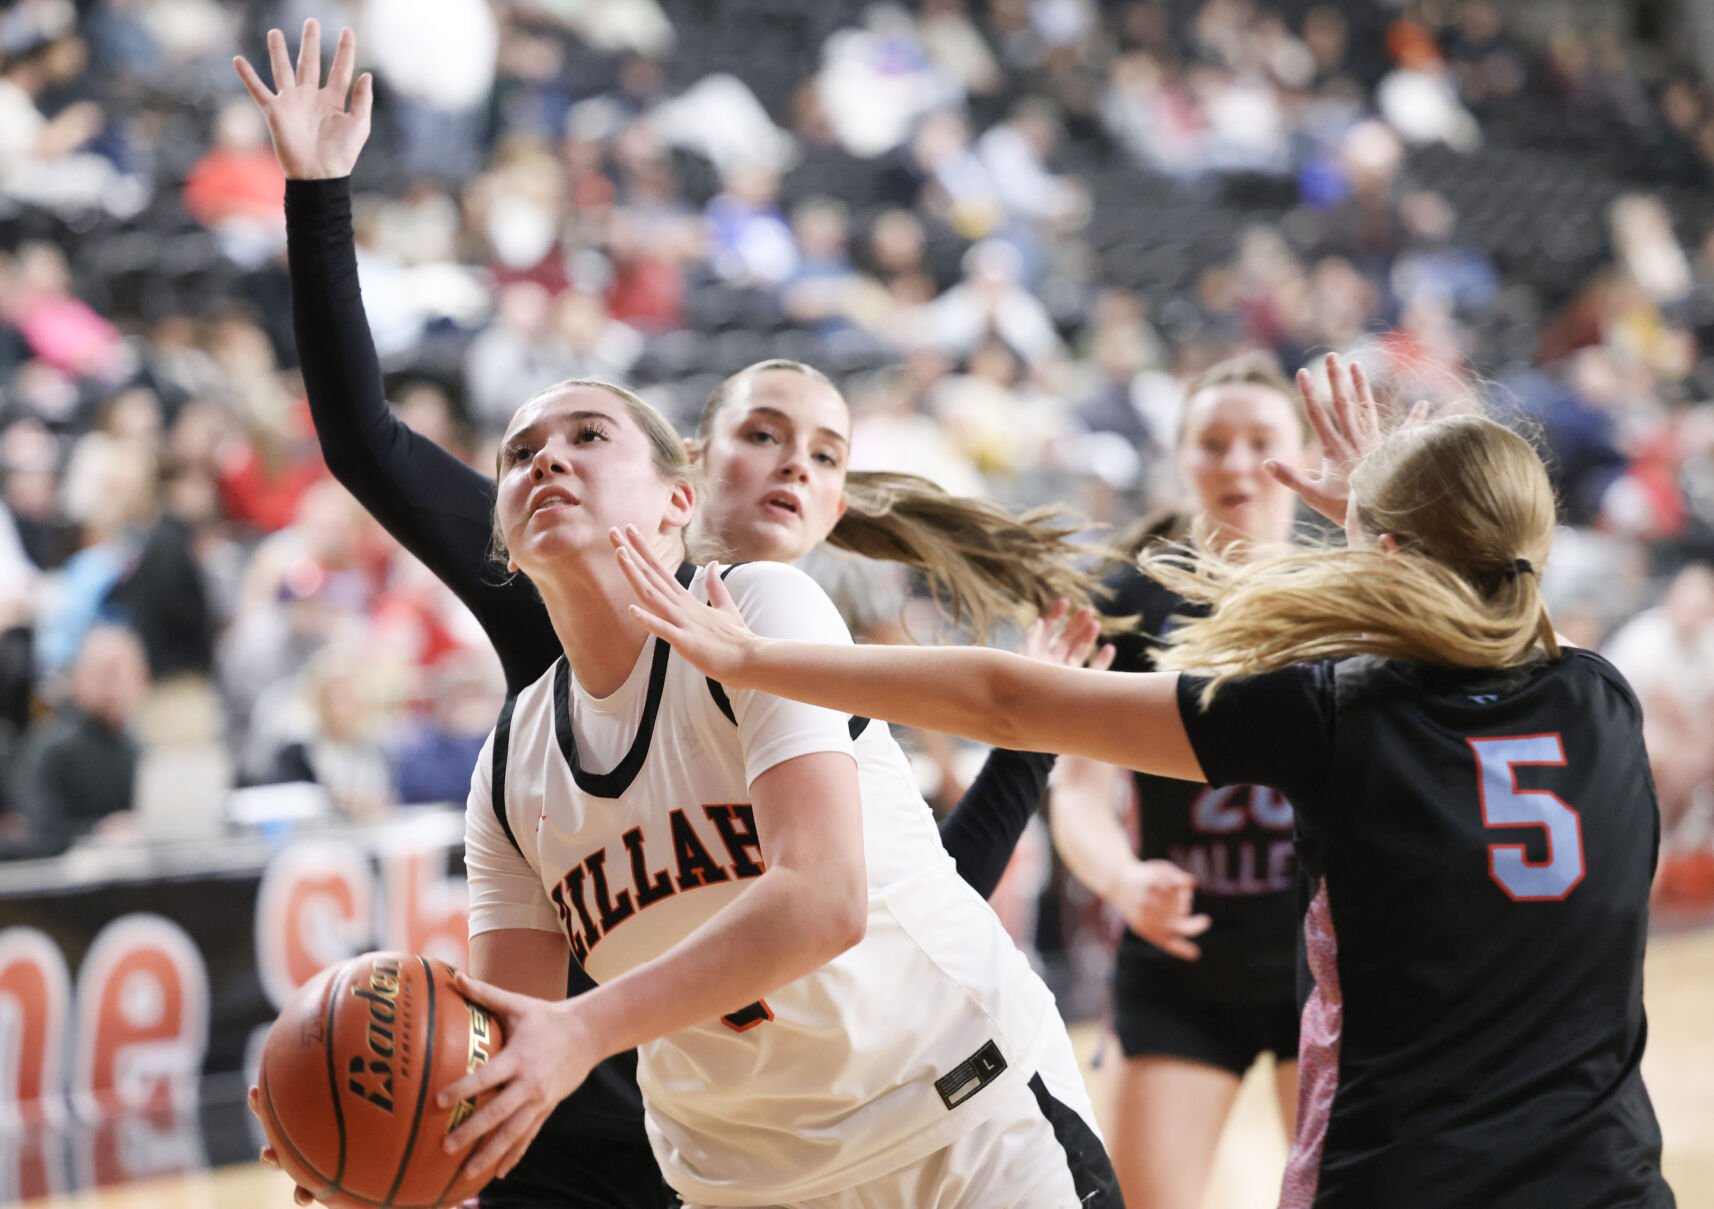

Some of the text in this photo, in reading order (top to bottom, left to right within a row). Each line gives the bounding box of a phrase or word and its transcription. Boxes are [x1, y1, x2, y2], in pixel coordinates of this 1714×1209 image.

[1466, 732, 1586, 902] 5
[349, 959, 402, 1113] Baden
[982, 1058, 996, 1071] L
